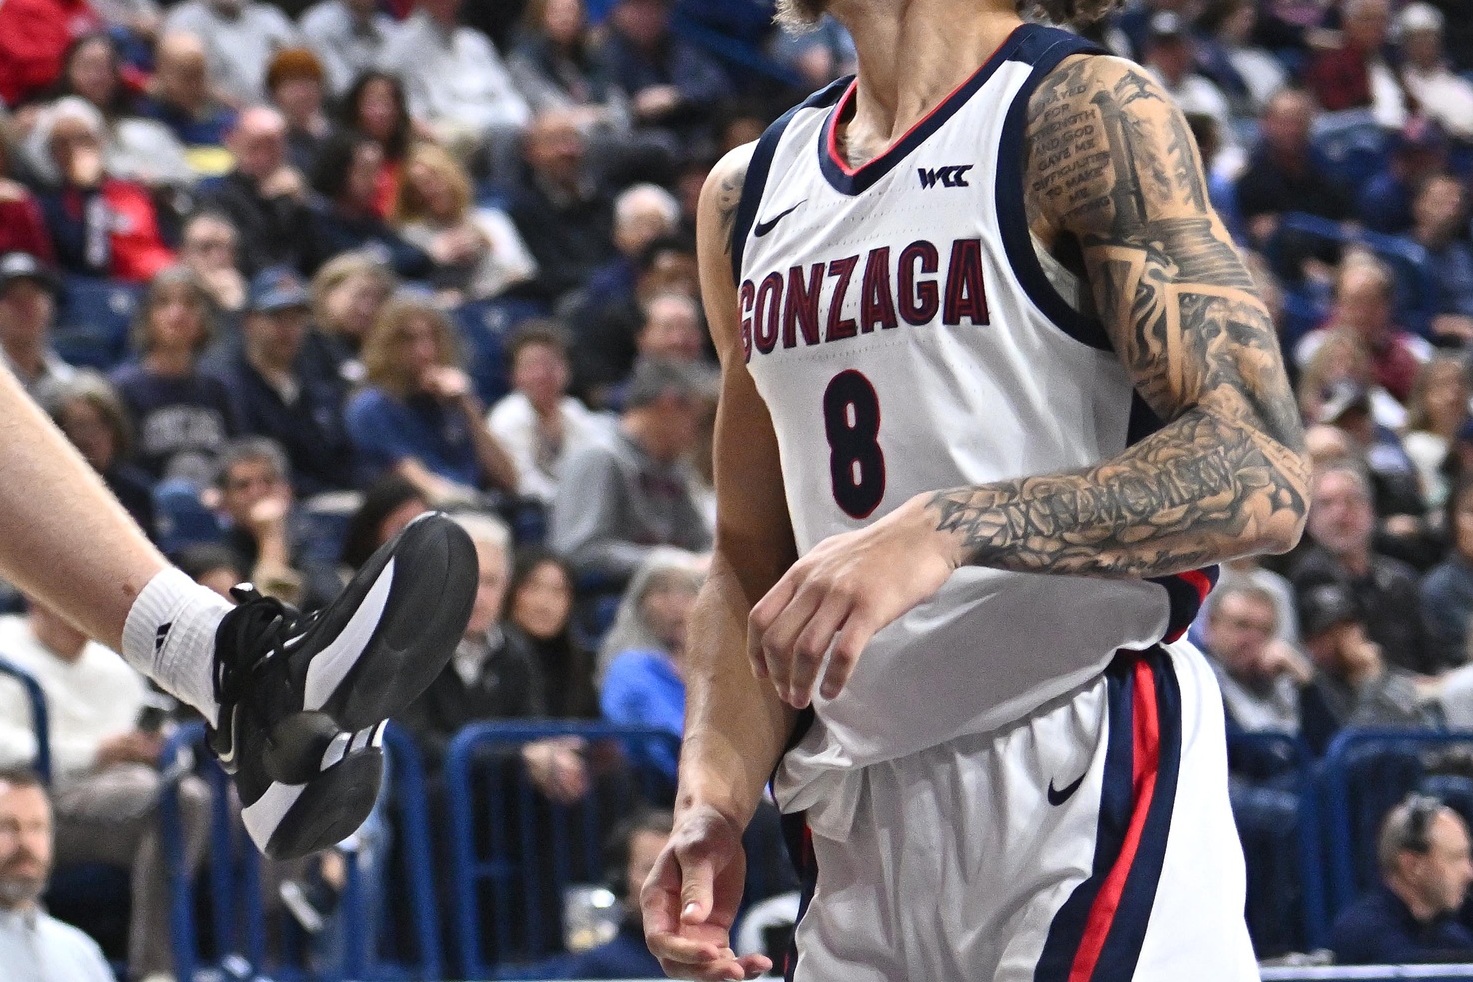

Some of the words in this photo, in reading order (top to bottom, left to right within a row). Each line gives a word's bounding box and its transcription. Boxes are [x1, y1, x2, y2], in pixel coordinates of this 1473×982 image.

[918, 165, 974, 190] WCC
[739, 238, 991, 364] GONZAGA
[823, 368, 886, 520] 8
